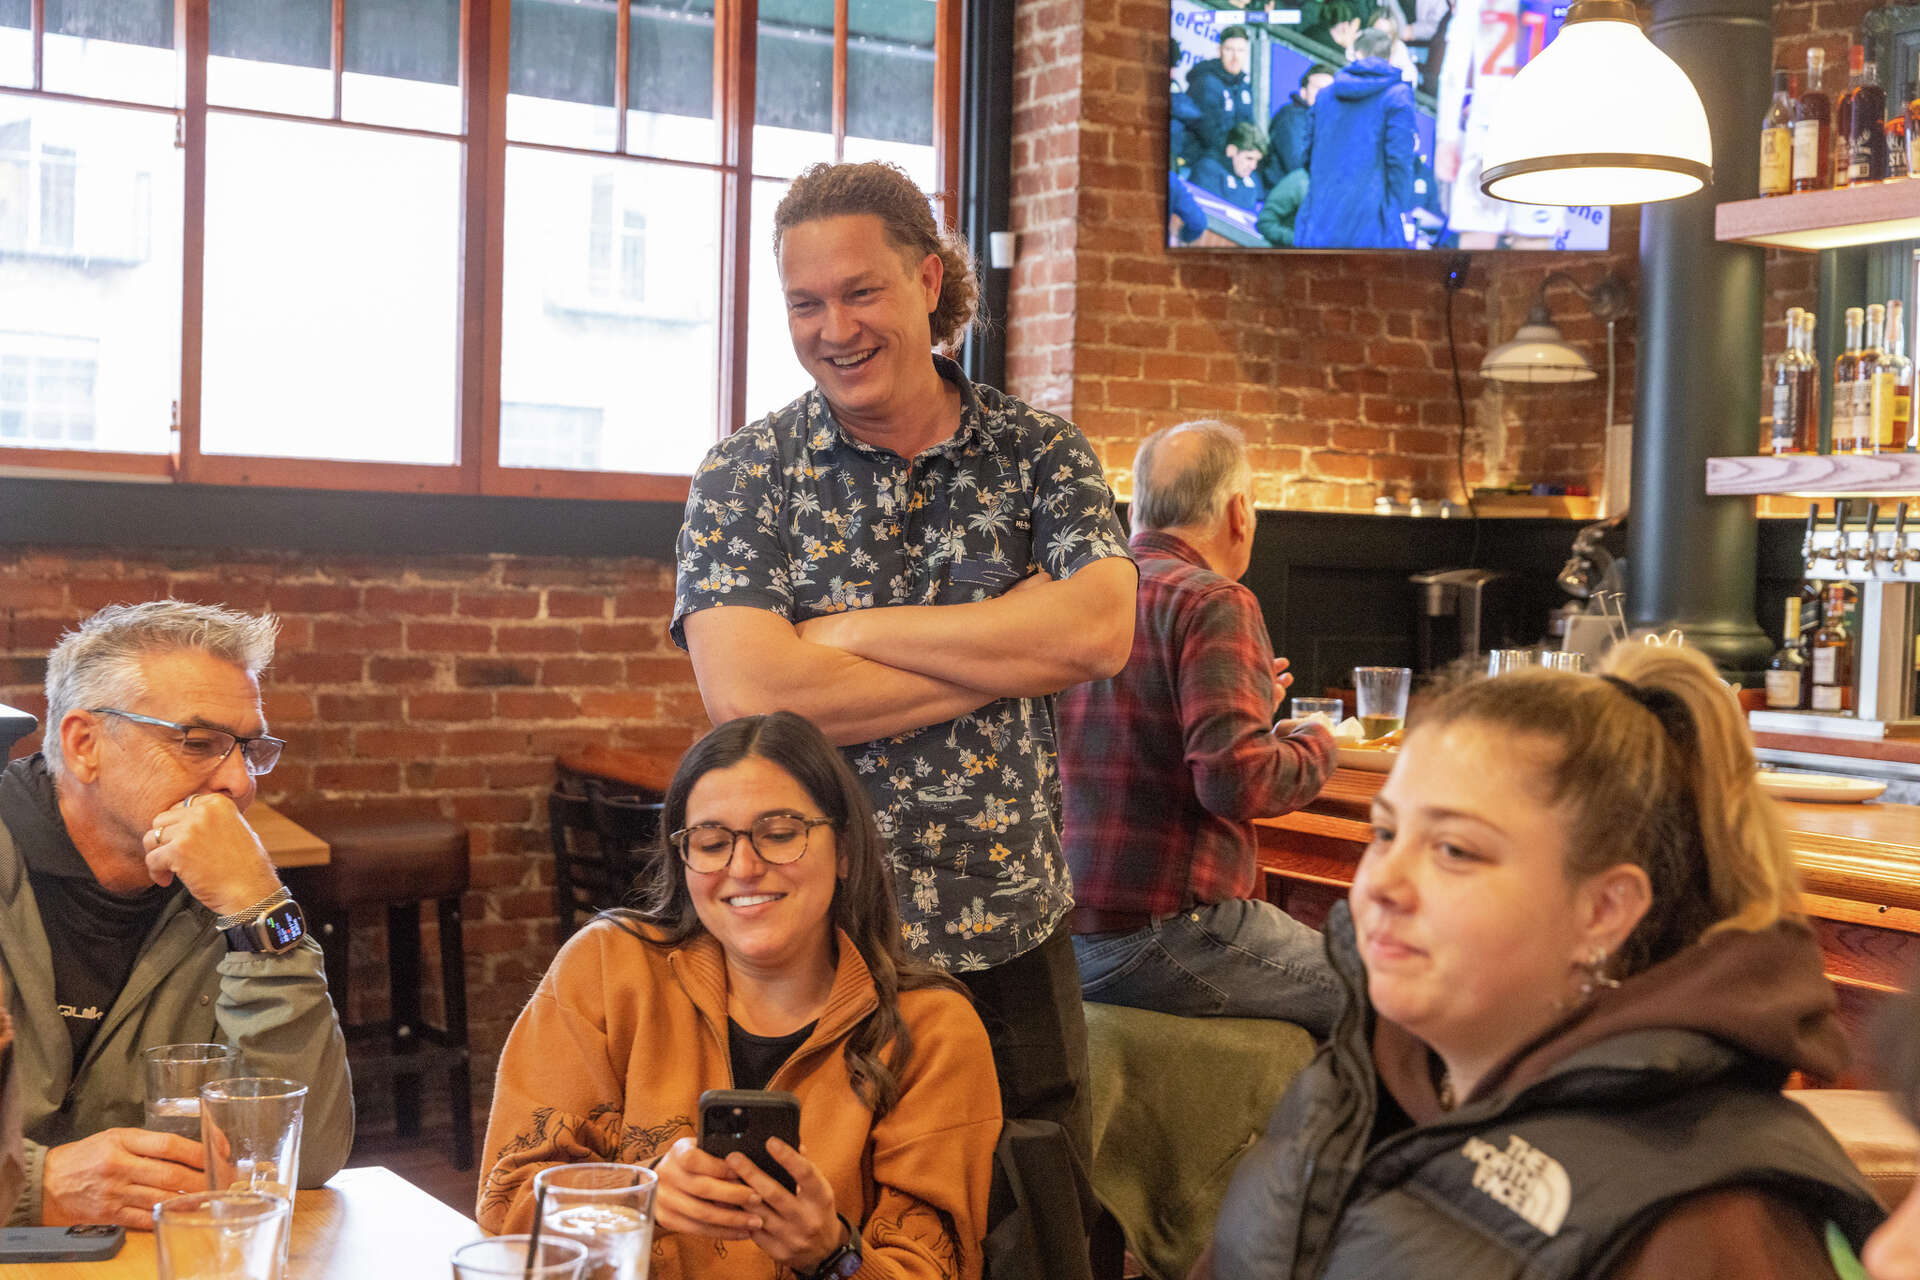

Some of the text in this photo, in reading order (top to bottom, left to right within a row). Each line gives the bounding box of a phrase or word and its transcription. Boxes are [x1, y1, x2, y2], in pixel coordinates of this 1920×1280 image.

[1461, 1136, 1538, 1195] NORTH
[1505, 1133, 1552, 1175] THE
[1470, 1166, 1530, 1215] FACE
